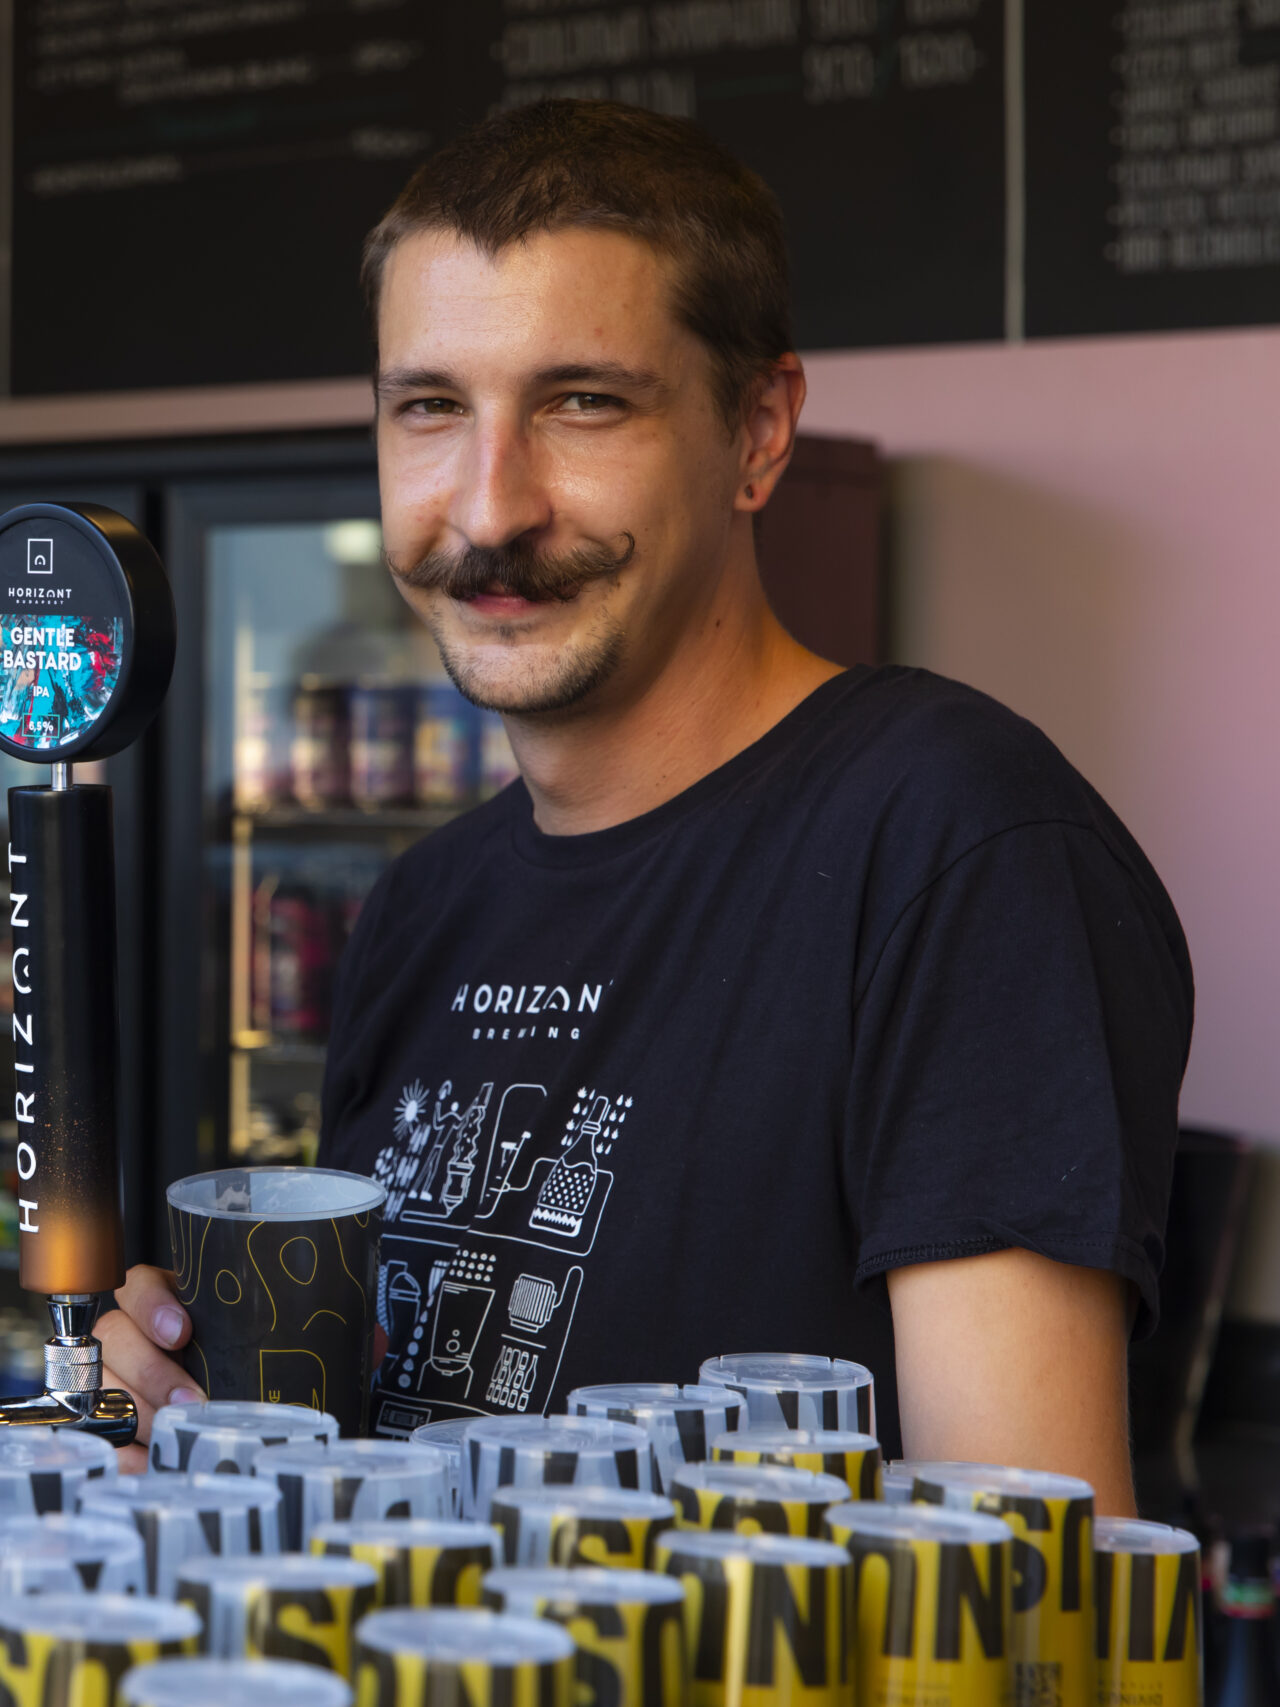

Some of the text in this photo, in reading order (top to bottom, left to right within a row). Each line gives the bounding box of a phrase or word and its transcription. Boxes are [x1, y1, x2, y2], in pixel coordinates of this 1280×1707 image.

[10, 627, 75, 647] GENTLE
[3, 650, 82, 671] BASTARD
[32, 685, 50, 698] IPA
[451, 978, 614, 1014] HORIZON
